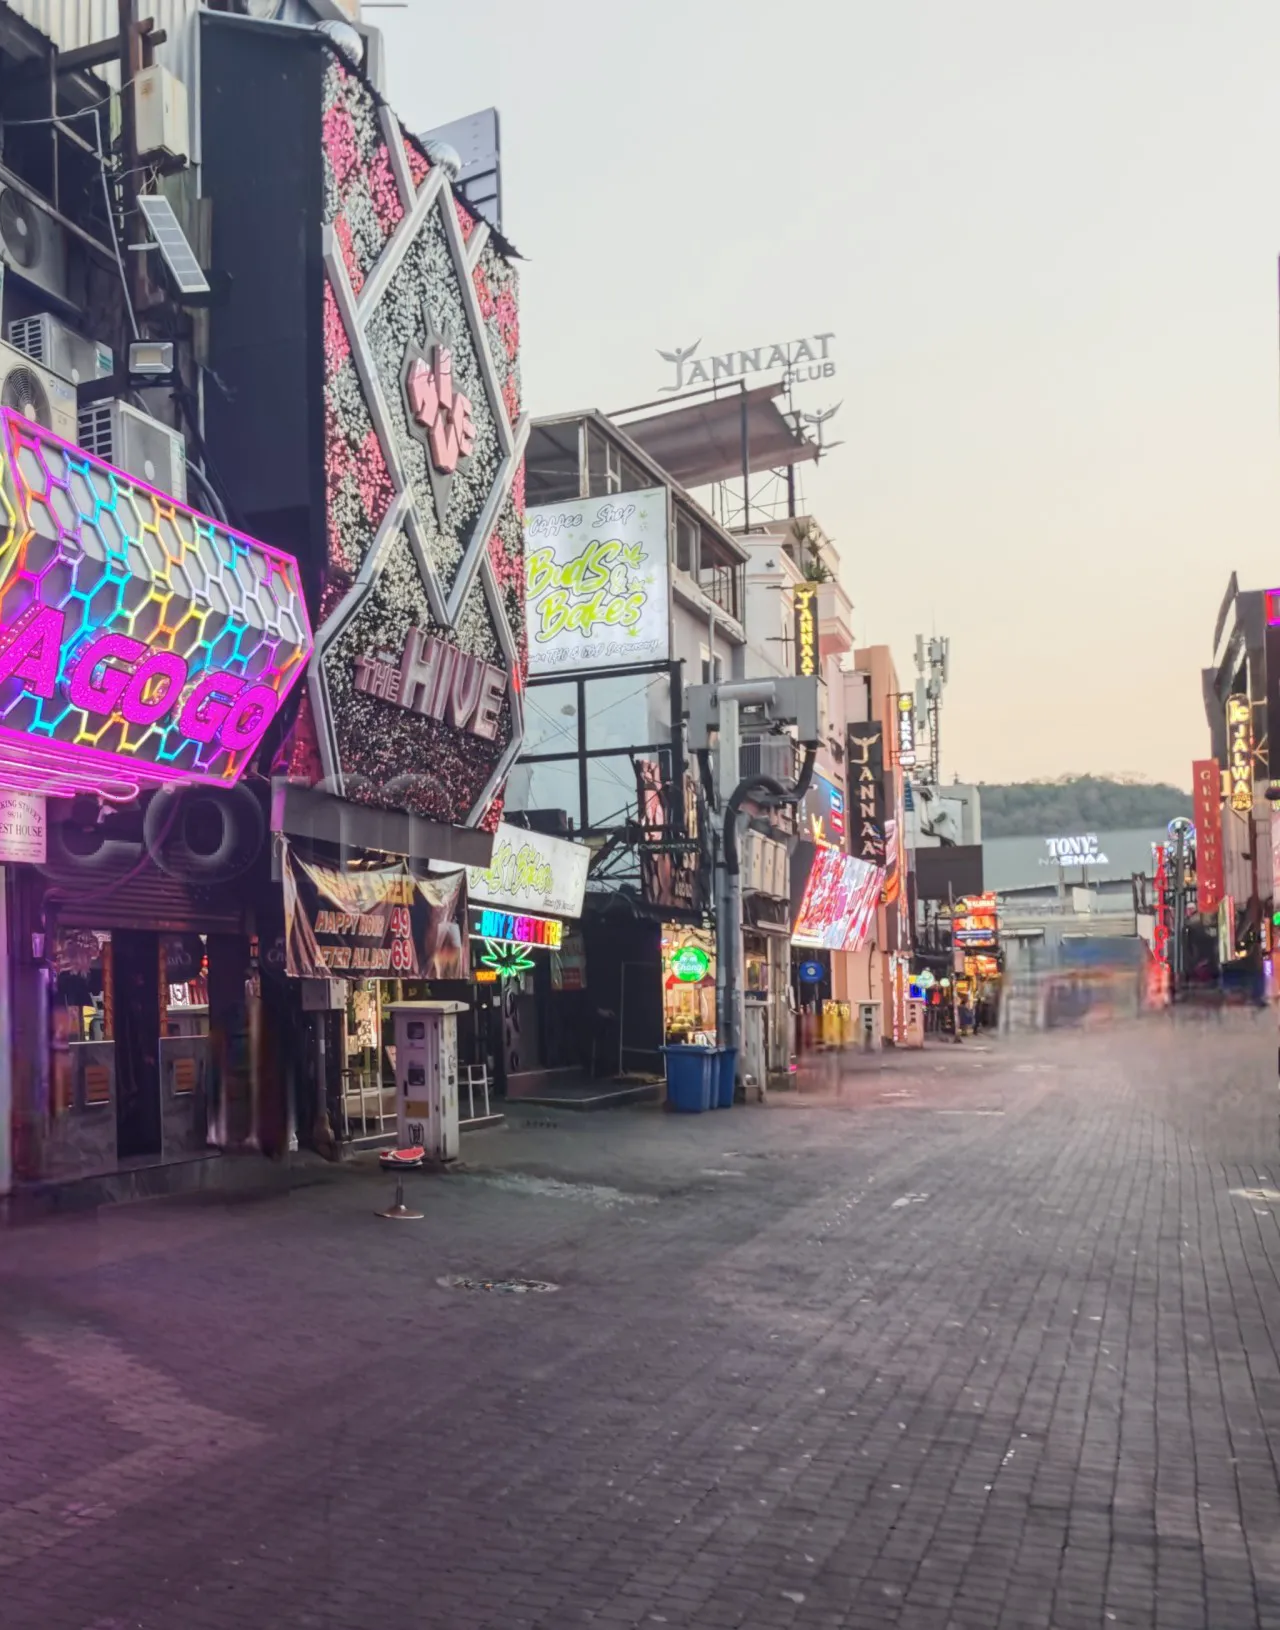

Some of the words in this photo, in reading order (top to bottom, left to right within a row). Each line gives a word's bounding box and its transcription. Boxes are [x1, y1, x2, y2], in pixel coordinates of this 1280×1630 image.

[655, 332, 835, 392] JANNAAT
[781, 362, 836, 385] CLUB
[529, 513, 583, 537] Coffee
[592, 504, 636, 528] Shop
[354, 655, 402, 703] THE
[400, 626, 508, 742] HIVE
[850, 733, 881, 863] JANNAA
[16, 824, 42, 838] HOUSE
[315, 911, 359, 935] HAPPY
[391, 907, 410, 938] 49
[481, 910, 506, 938] BUY
[506, 914, 513, 940] 2
[514, 915, 536, 942] GET
[391, 939, 412, 970] 69
